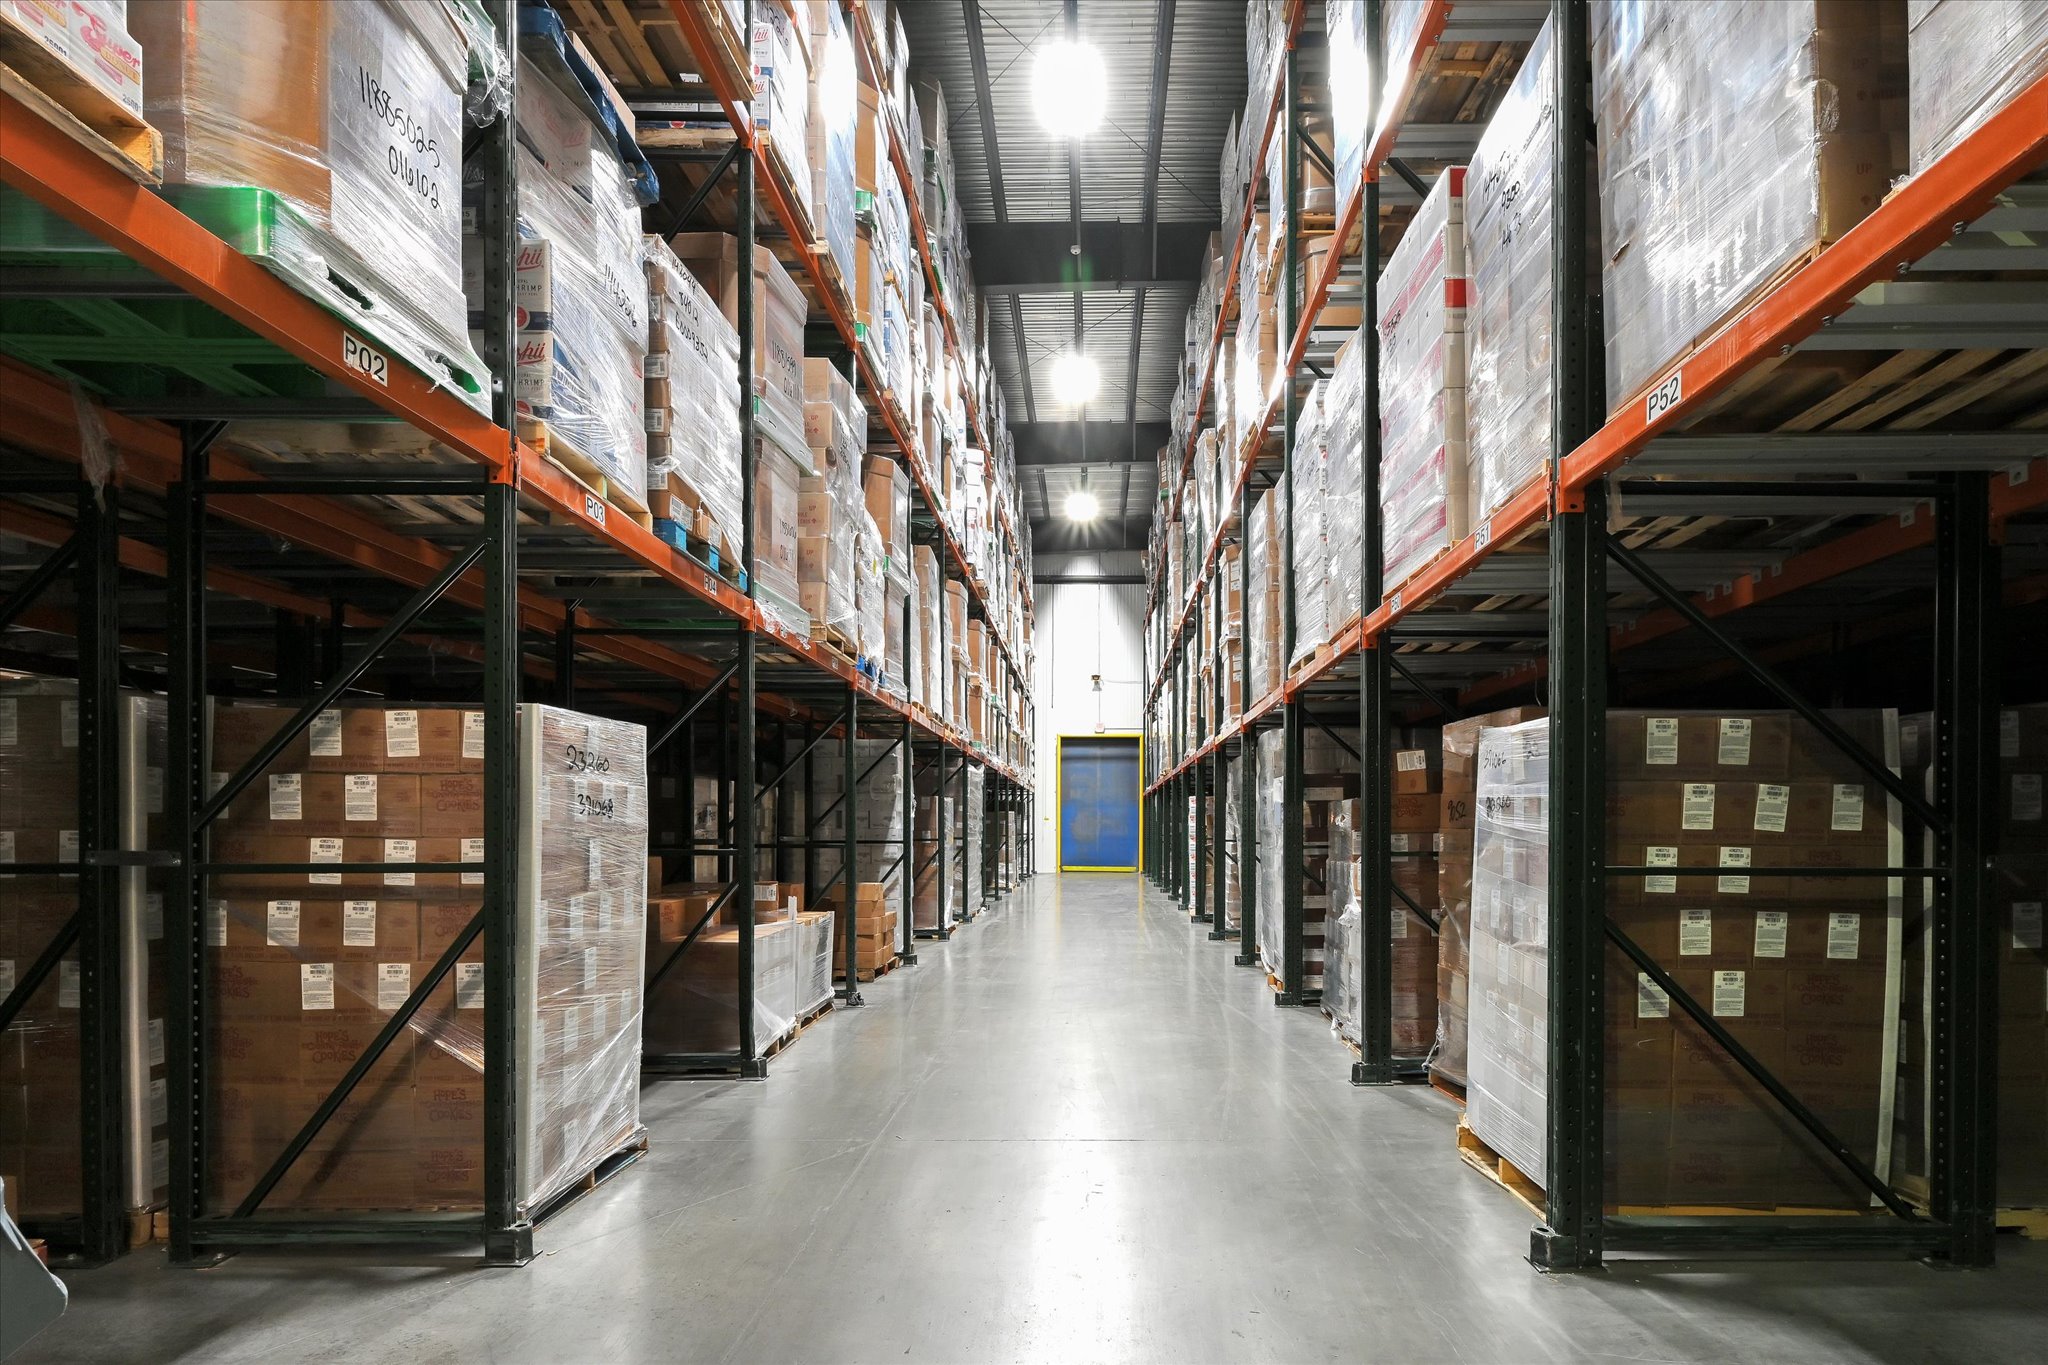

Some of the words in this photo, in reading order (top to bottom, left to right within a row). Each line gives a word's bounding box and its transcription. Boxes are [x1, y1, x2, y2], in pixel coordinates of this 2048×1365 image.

[360, 66, 440, 168] 11885025
[345, 335, 385, 382] P02
[1648, 376, 1679, 420] P52
[586, 497, 604, 523] P03
[1475, 528, 1490, 552] P51
